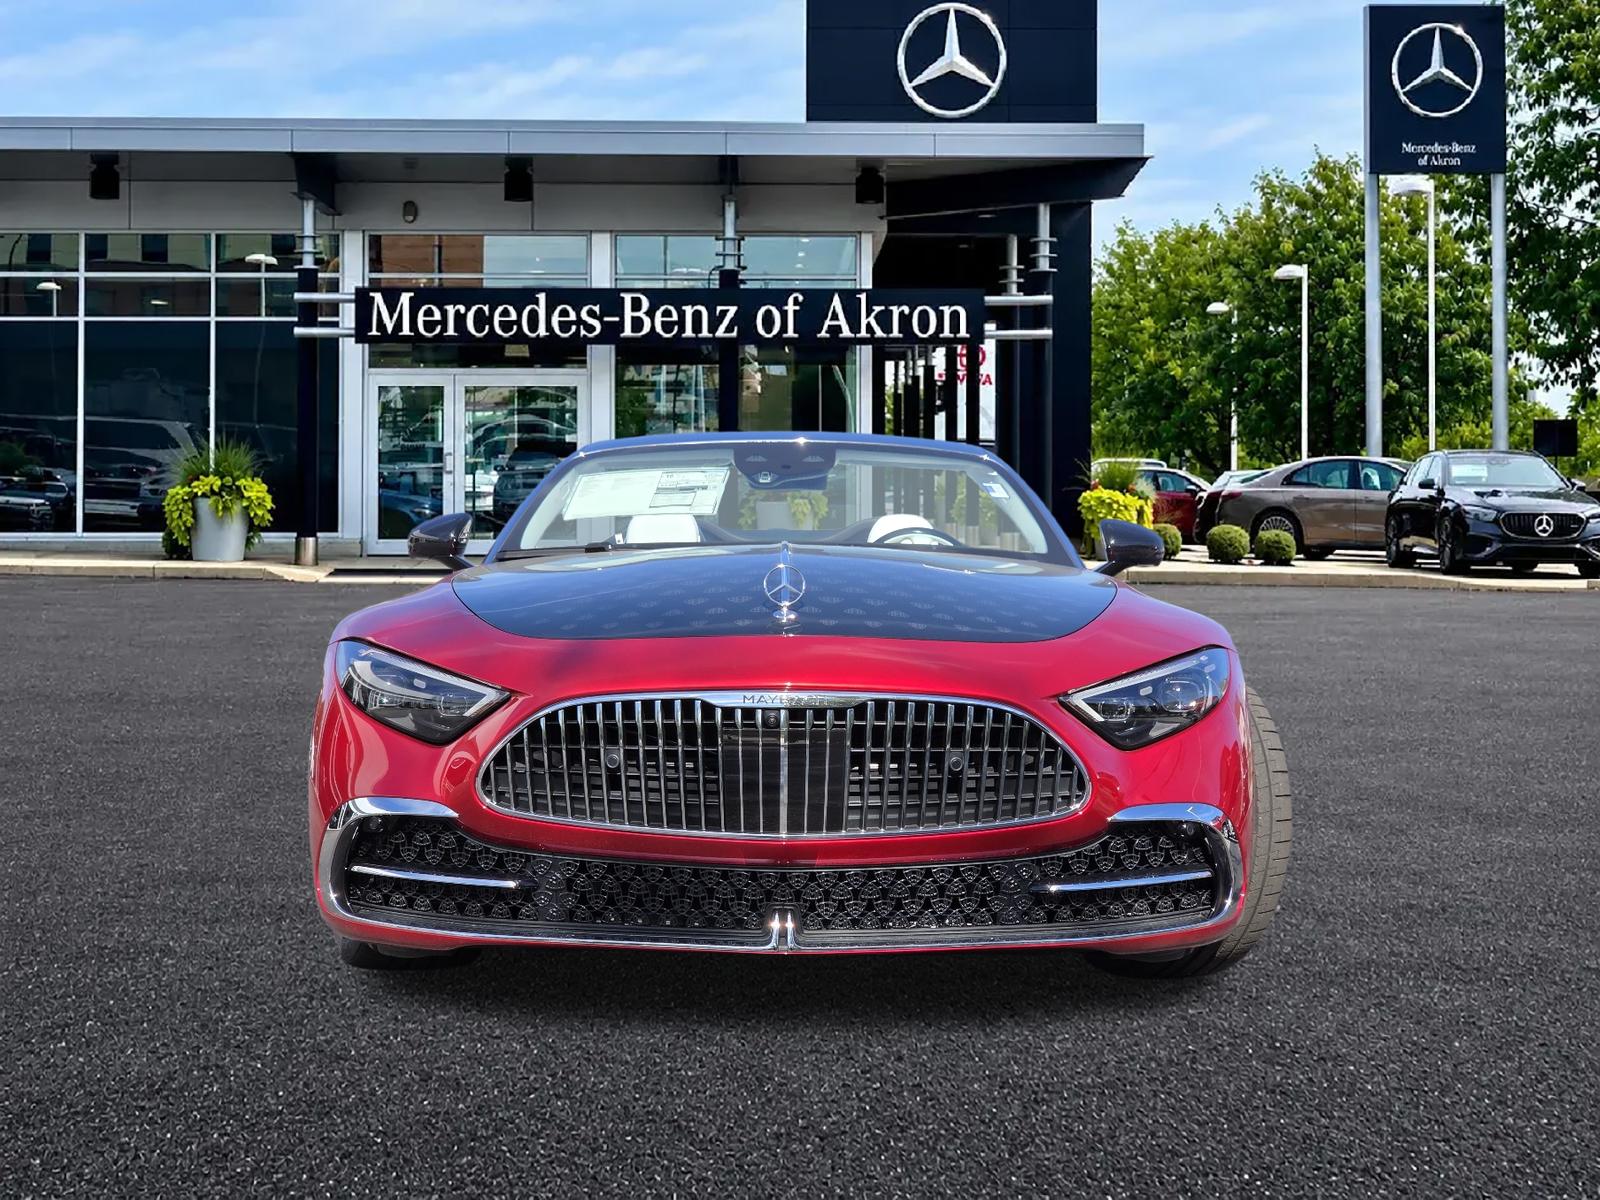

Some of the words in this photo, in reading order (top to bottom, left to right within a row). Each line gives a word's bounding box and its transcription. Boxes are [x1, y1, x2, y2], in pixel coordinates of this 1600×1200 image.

[1418, 154, 1429, 165] of
[1430, 154, 1461, 165] Akron
[368, 292, 738, 338] Mercedes-Benz
[755, 292, 804, 338] of
[816, 292, 971, 338] Akron
